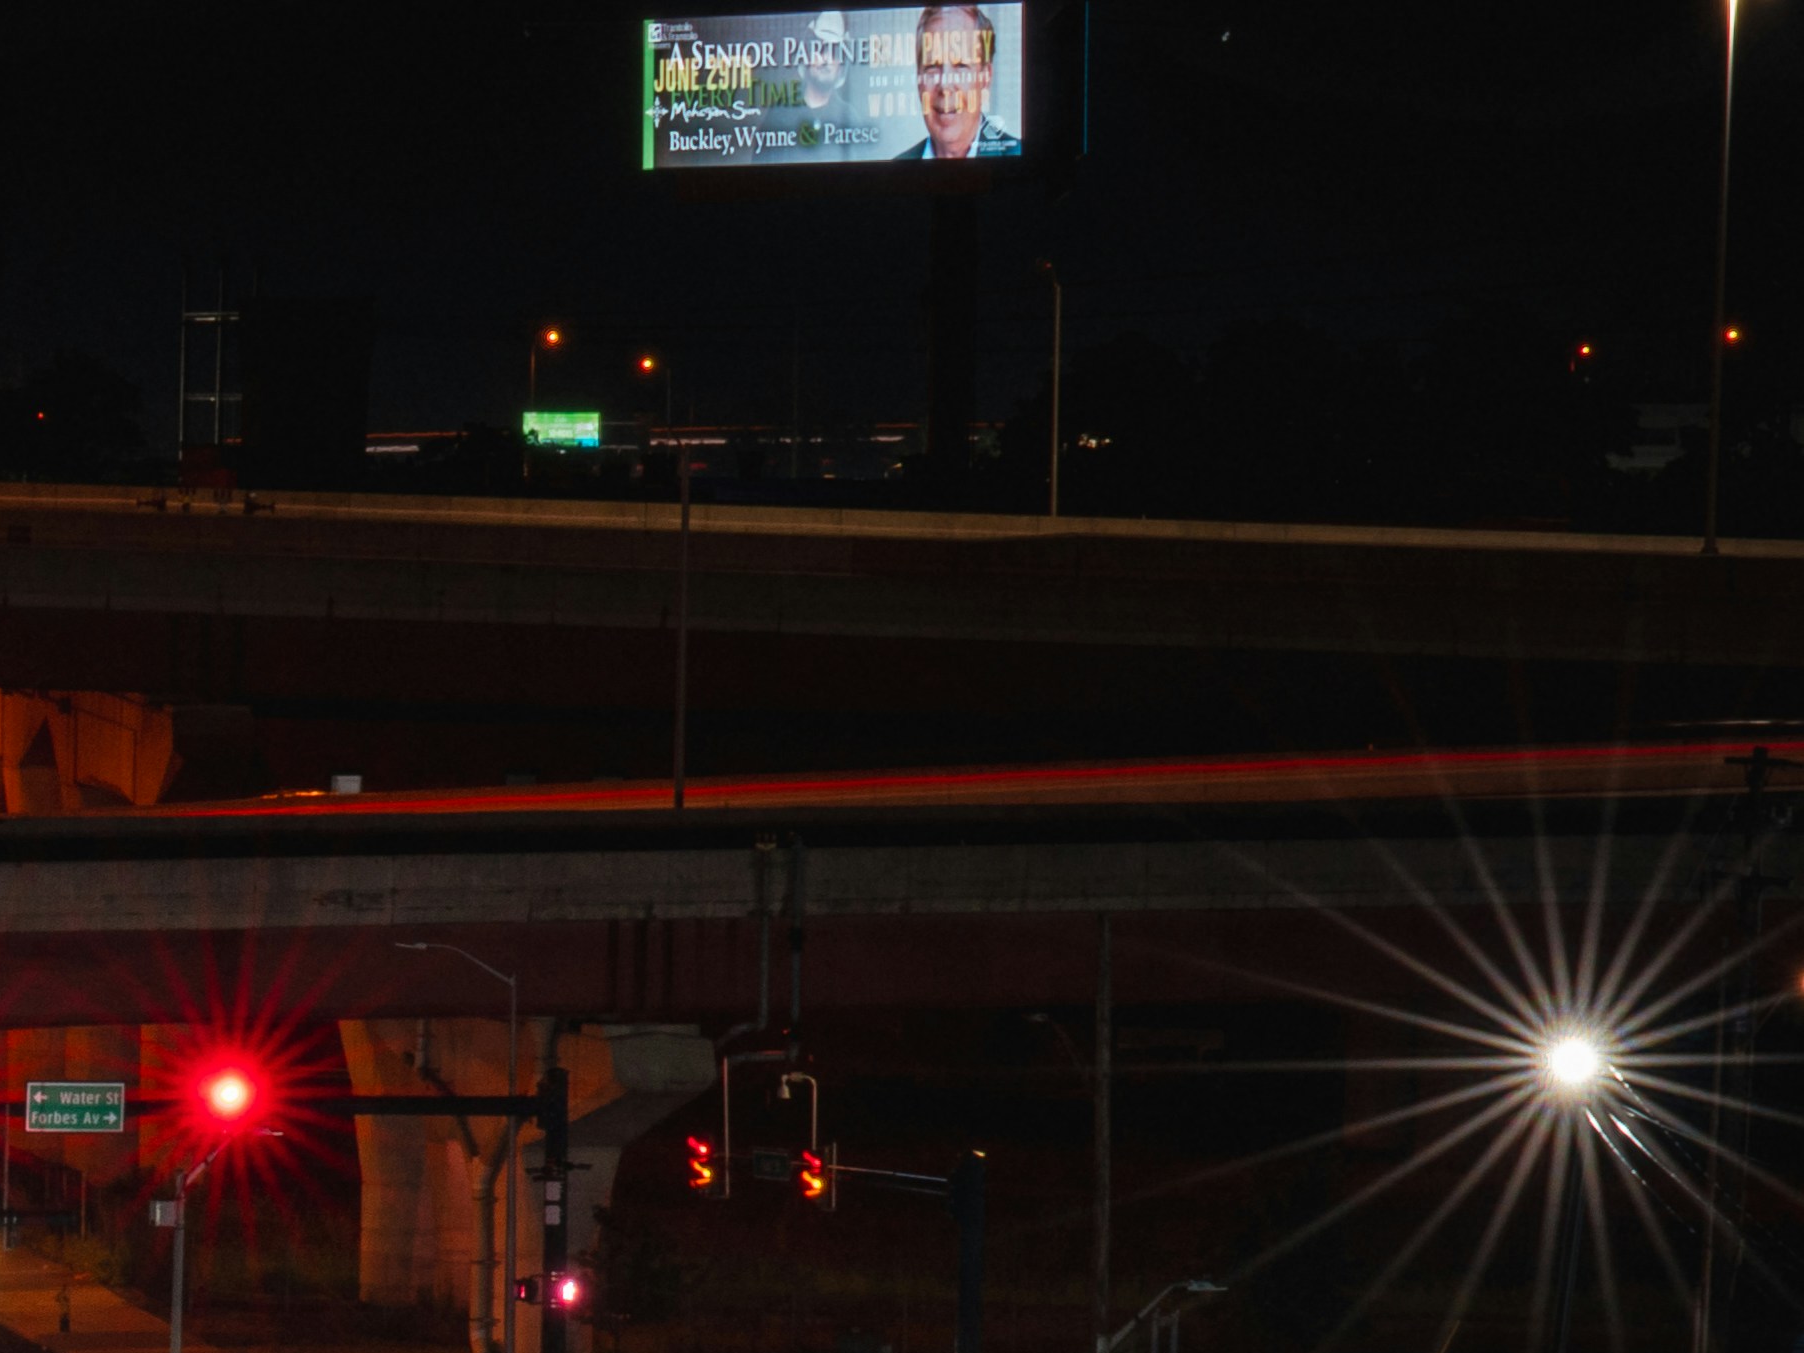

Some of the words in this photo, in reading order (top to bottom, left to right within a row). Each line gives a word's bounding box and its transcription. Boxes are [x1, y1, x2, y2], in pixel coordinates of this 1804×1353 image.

[668, 42, 685, 71] A
[922, 30, 994, 65] PAISLEY
[654, 57, 700, 92] JUNE
[707, 55, 752, 91] 29TH
[734, 126, 797, 154] Wynne
[799, 122, 819, 147] &
[824, 122, 879, 145] Parese
[59, 1092, 101, 1105] Water
[105, 1092, 120, 1105] St
[31, 1111, 78, 1124] Forbes
[83, 1111, 101, 1124] Av
